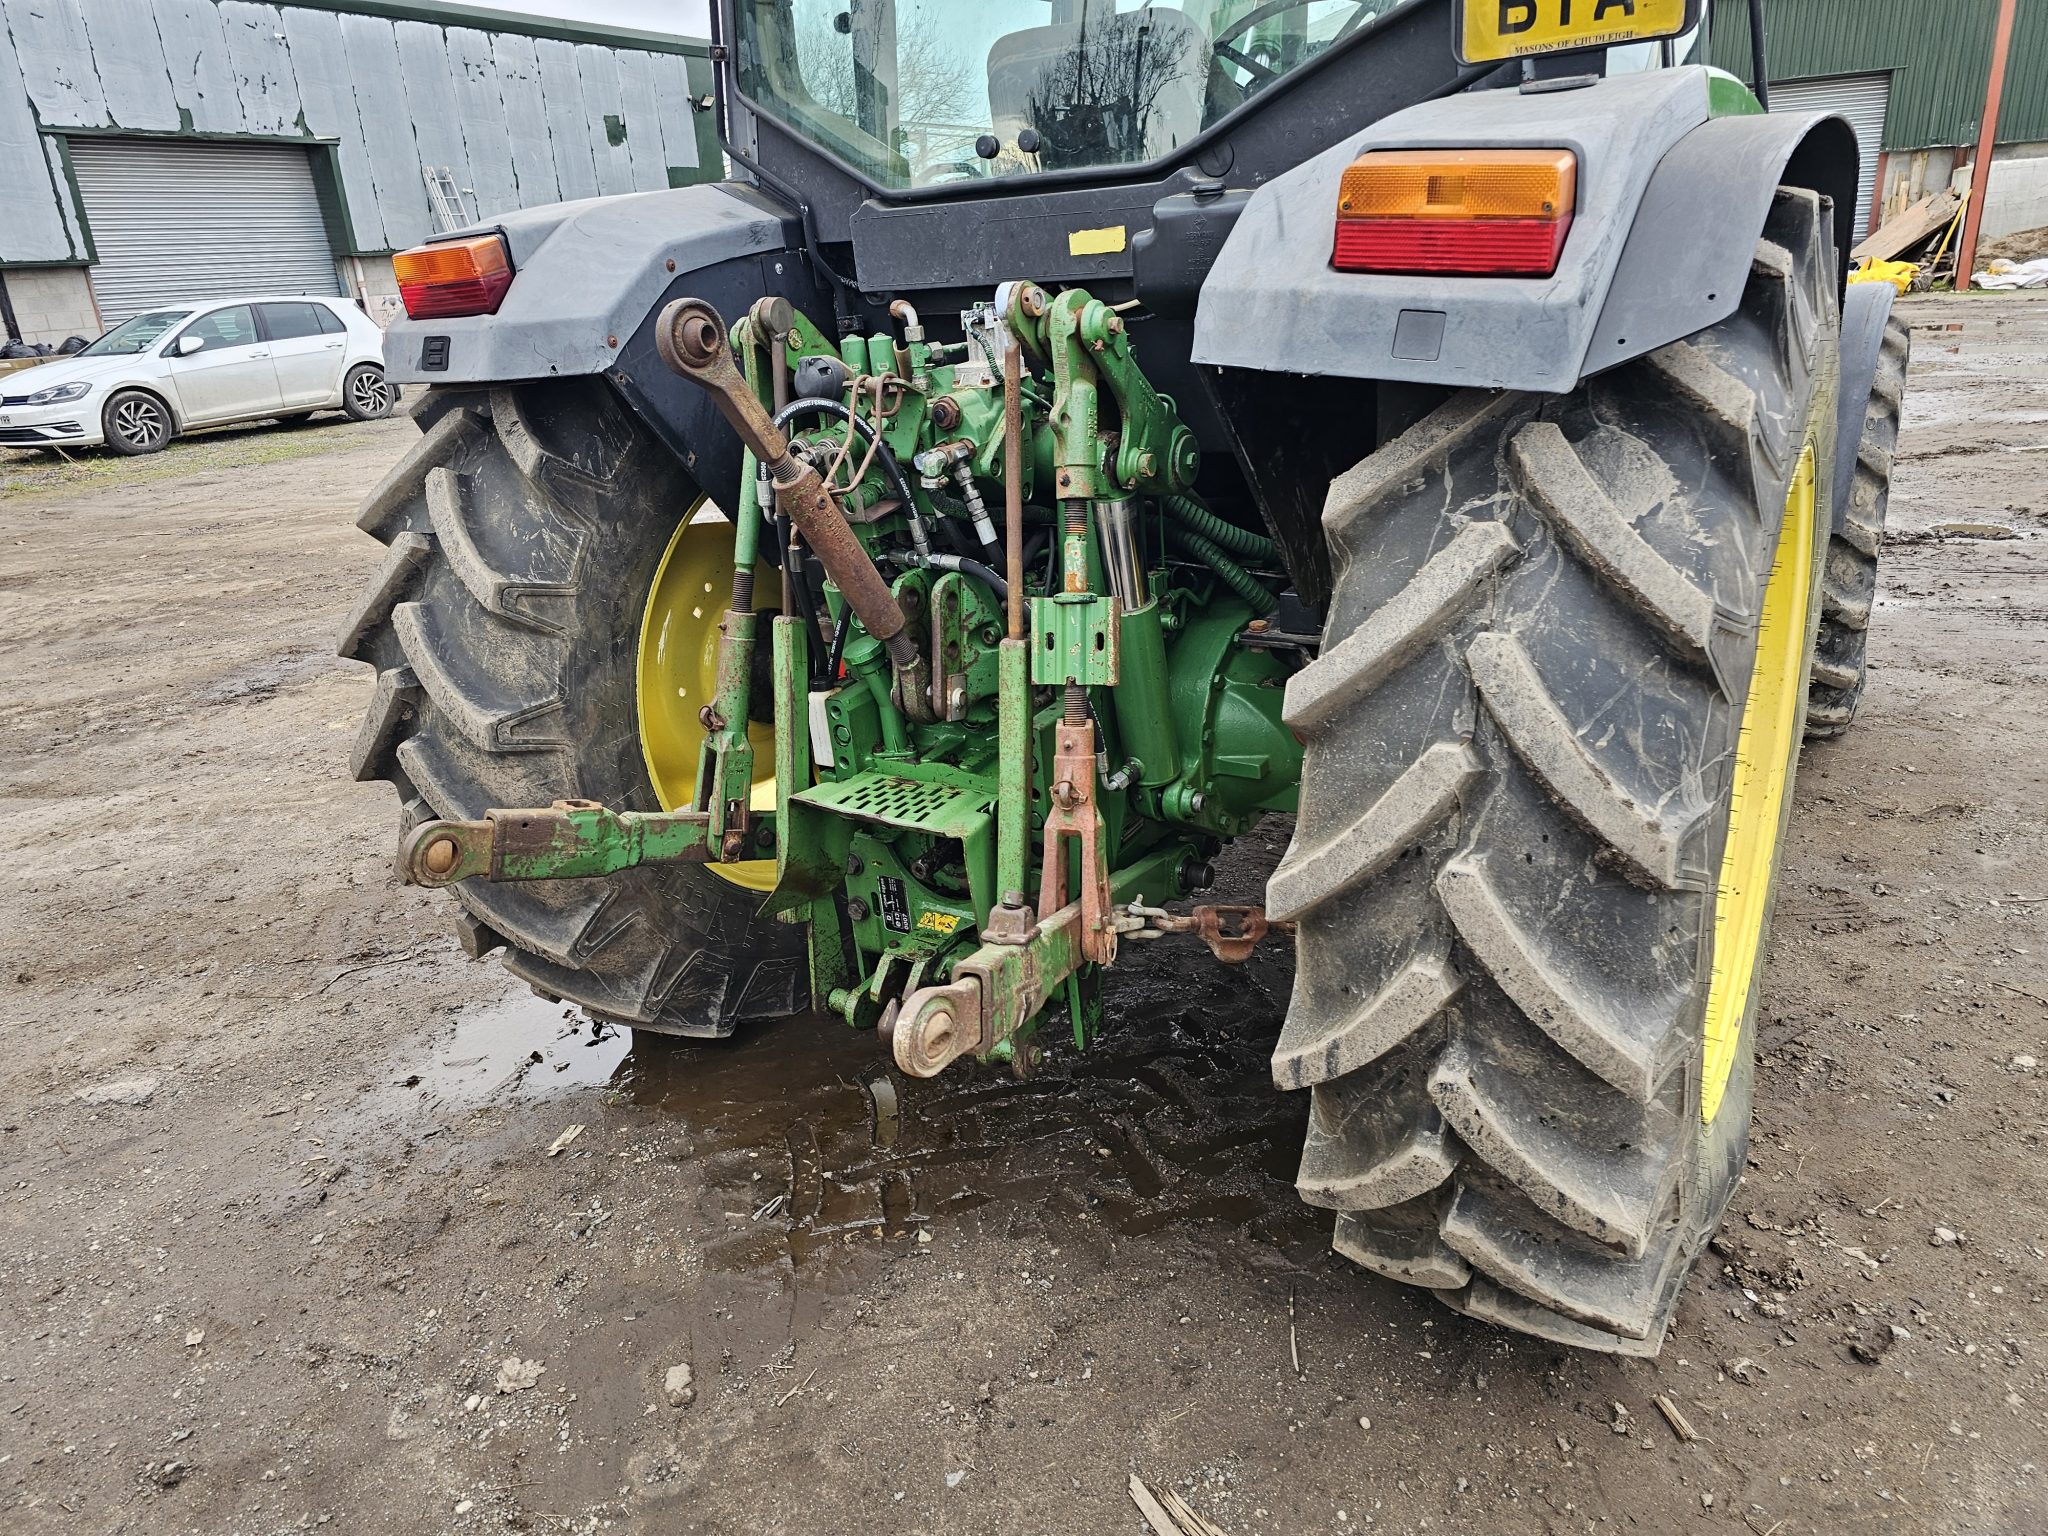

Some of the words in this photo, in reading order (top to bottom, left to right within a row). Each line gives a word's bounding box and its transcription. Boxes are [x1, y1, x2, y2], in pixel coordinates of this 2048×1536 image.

[1515, 42, 1554, 54] MASONS
[1557, 39, 1570, 48] OF
[1574, 30, 1633, 46] CHUDLEIGH
